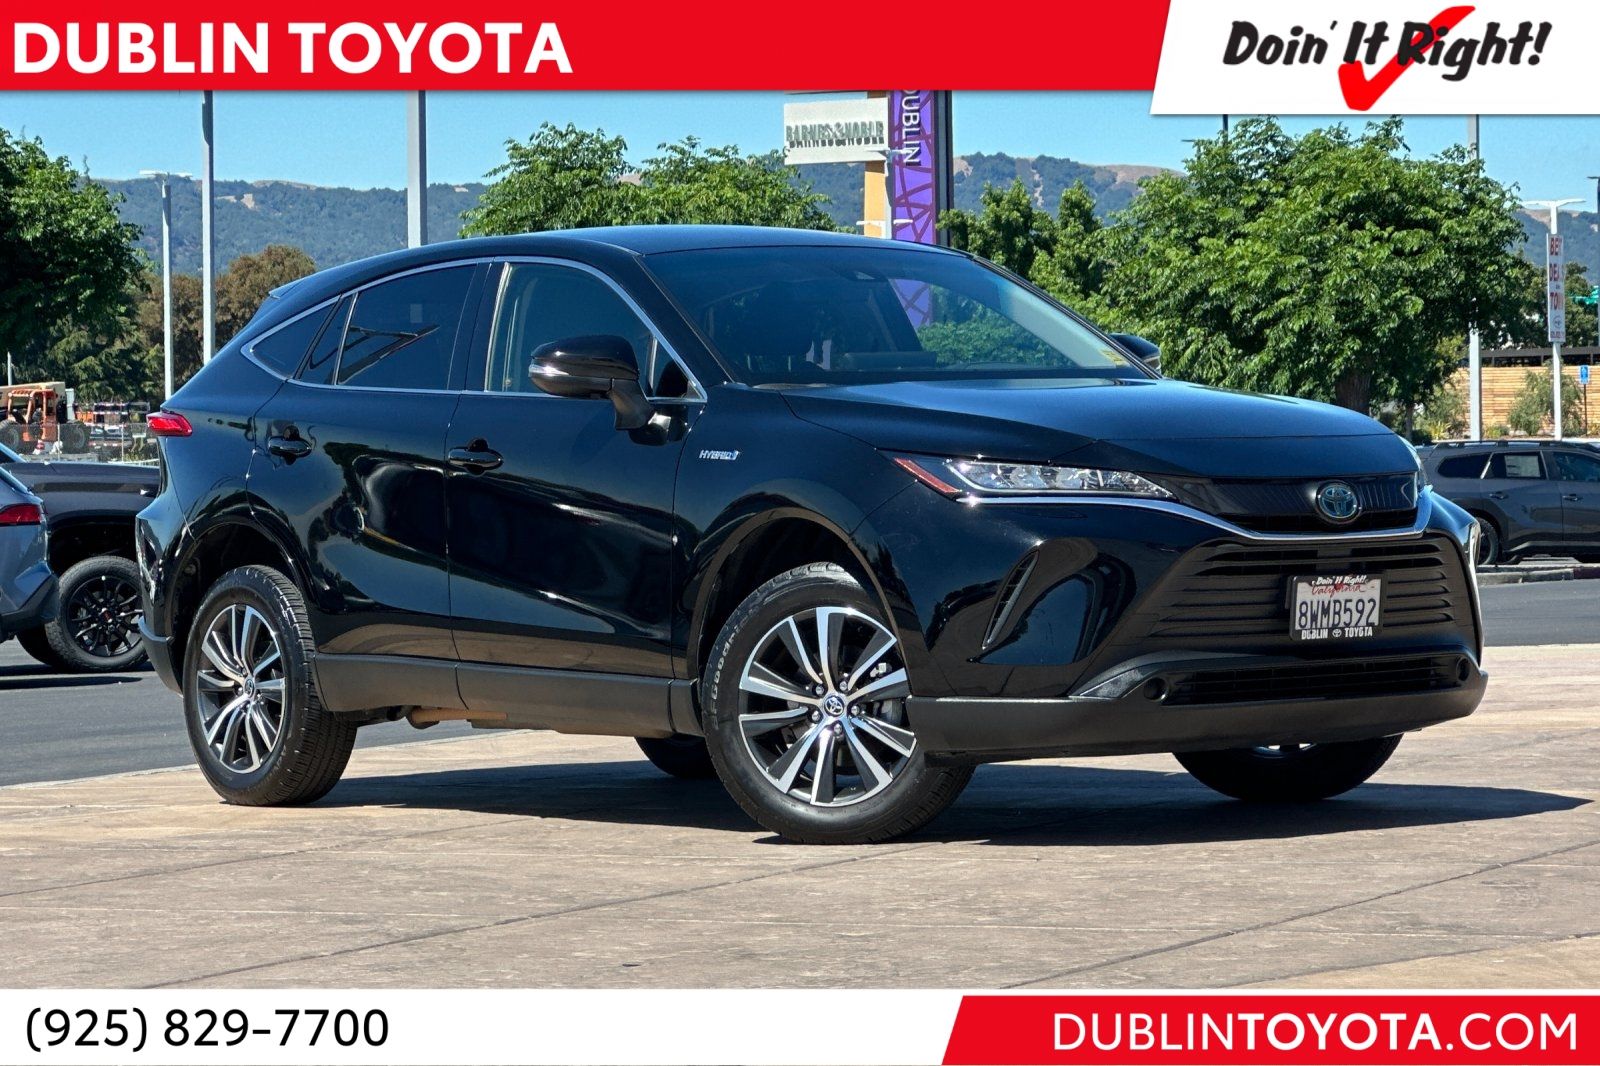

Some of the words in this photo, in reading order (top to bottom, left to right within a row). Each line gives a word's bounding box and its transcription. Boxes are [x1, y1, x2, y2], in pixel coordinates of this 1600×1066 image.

[699, 449, 738, 460] HYBRID
[1311, 584, 1366, 598] Califnia
[1298, 598, 1377, 629] 8WMB592
[1301, 628, 1329, 640] DUBLIN
[1344, 626, 1373, 638] TOYOTA
